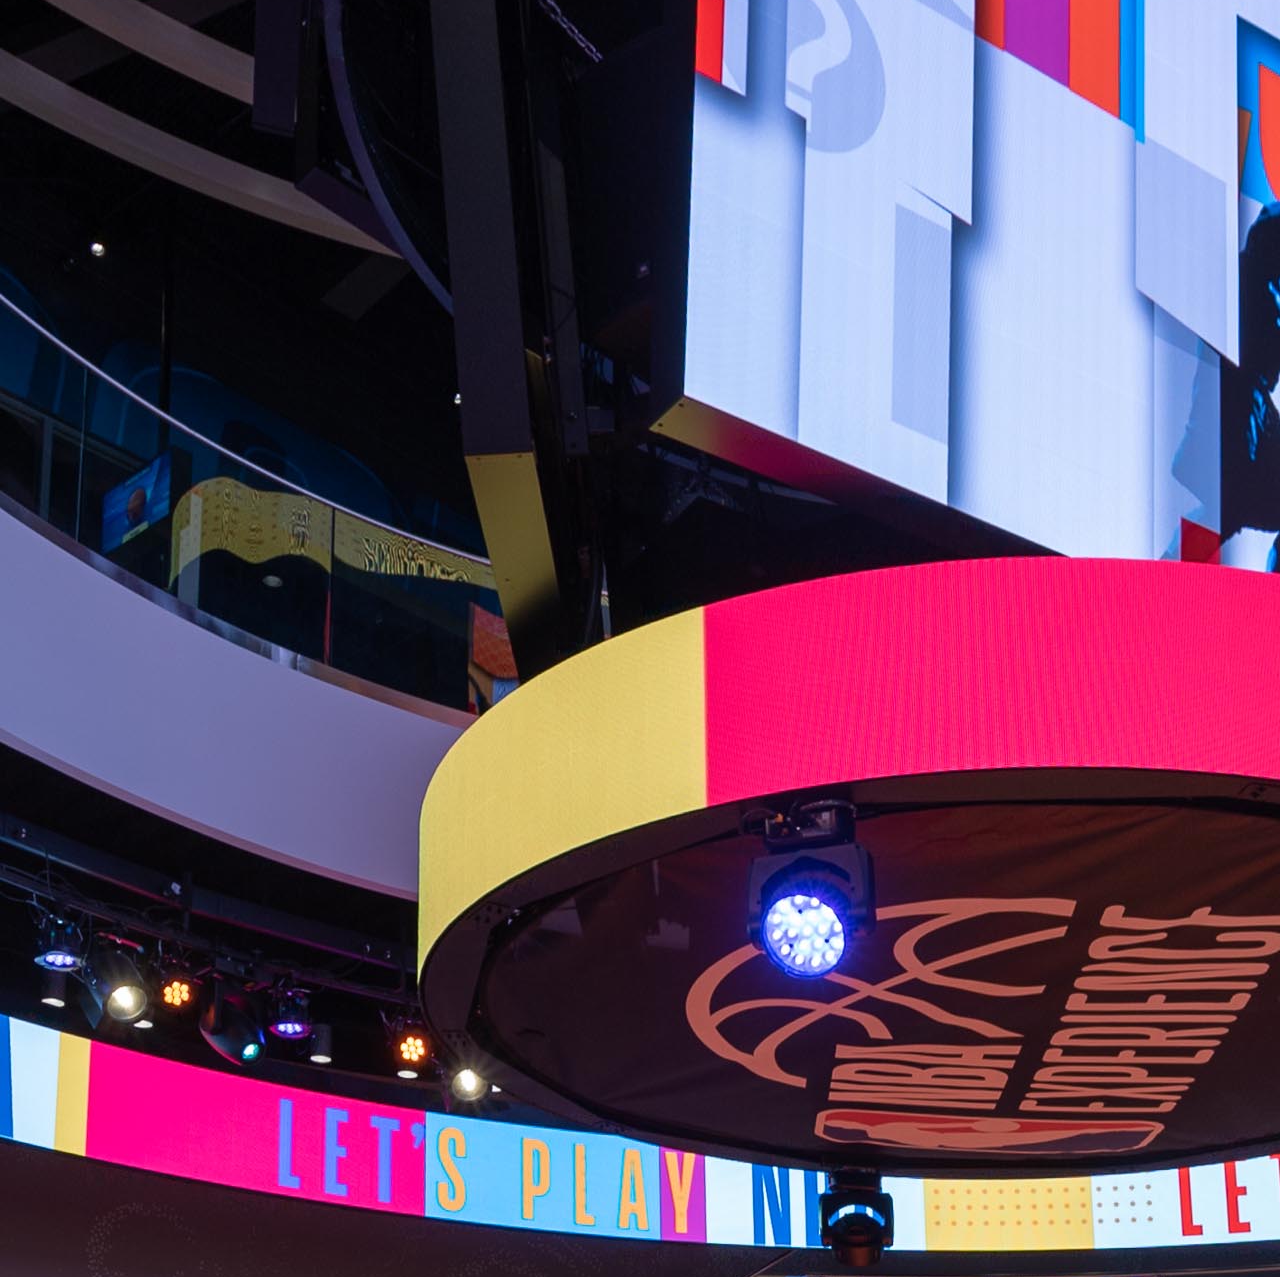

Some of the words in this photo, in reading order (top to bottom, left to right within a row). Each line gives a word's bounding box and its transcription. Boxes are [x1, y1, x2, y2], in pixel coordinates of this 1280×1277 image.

[827, 1043, 1022, 1110] NBA
[278, 1098, 468, 1213] LET'S
[522, 1137, 697, 1235] PLAY
